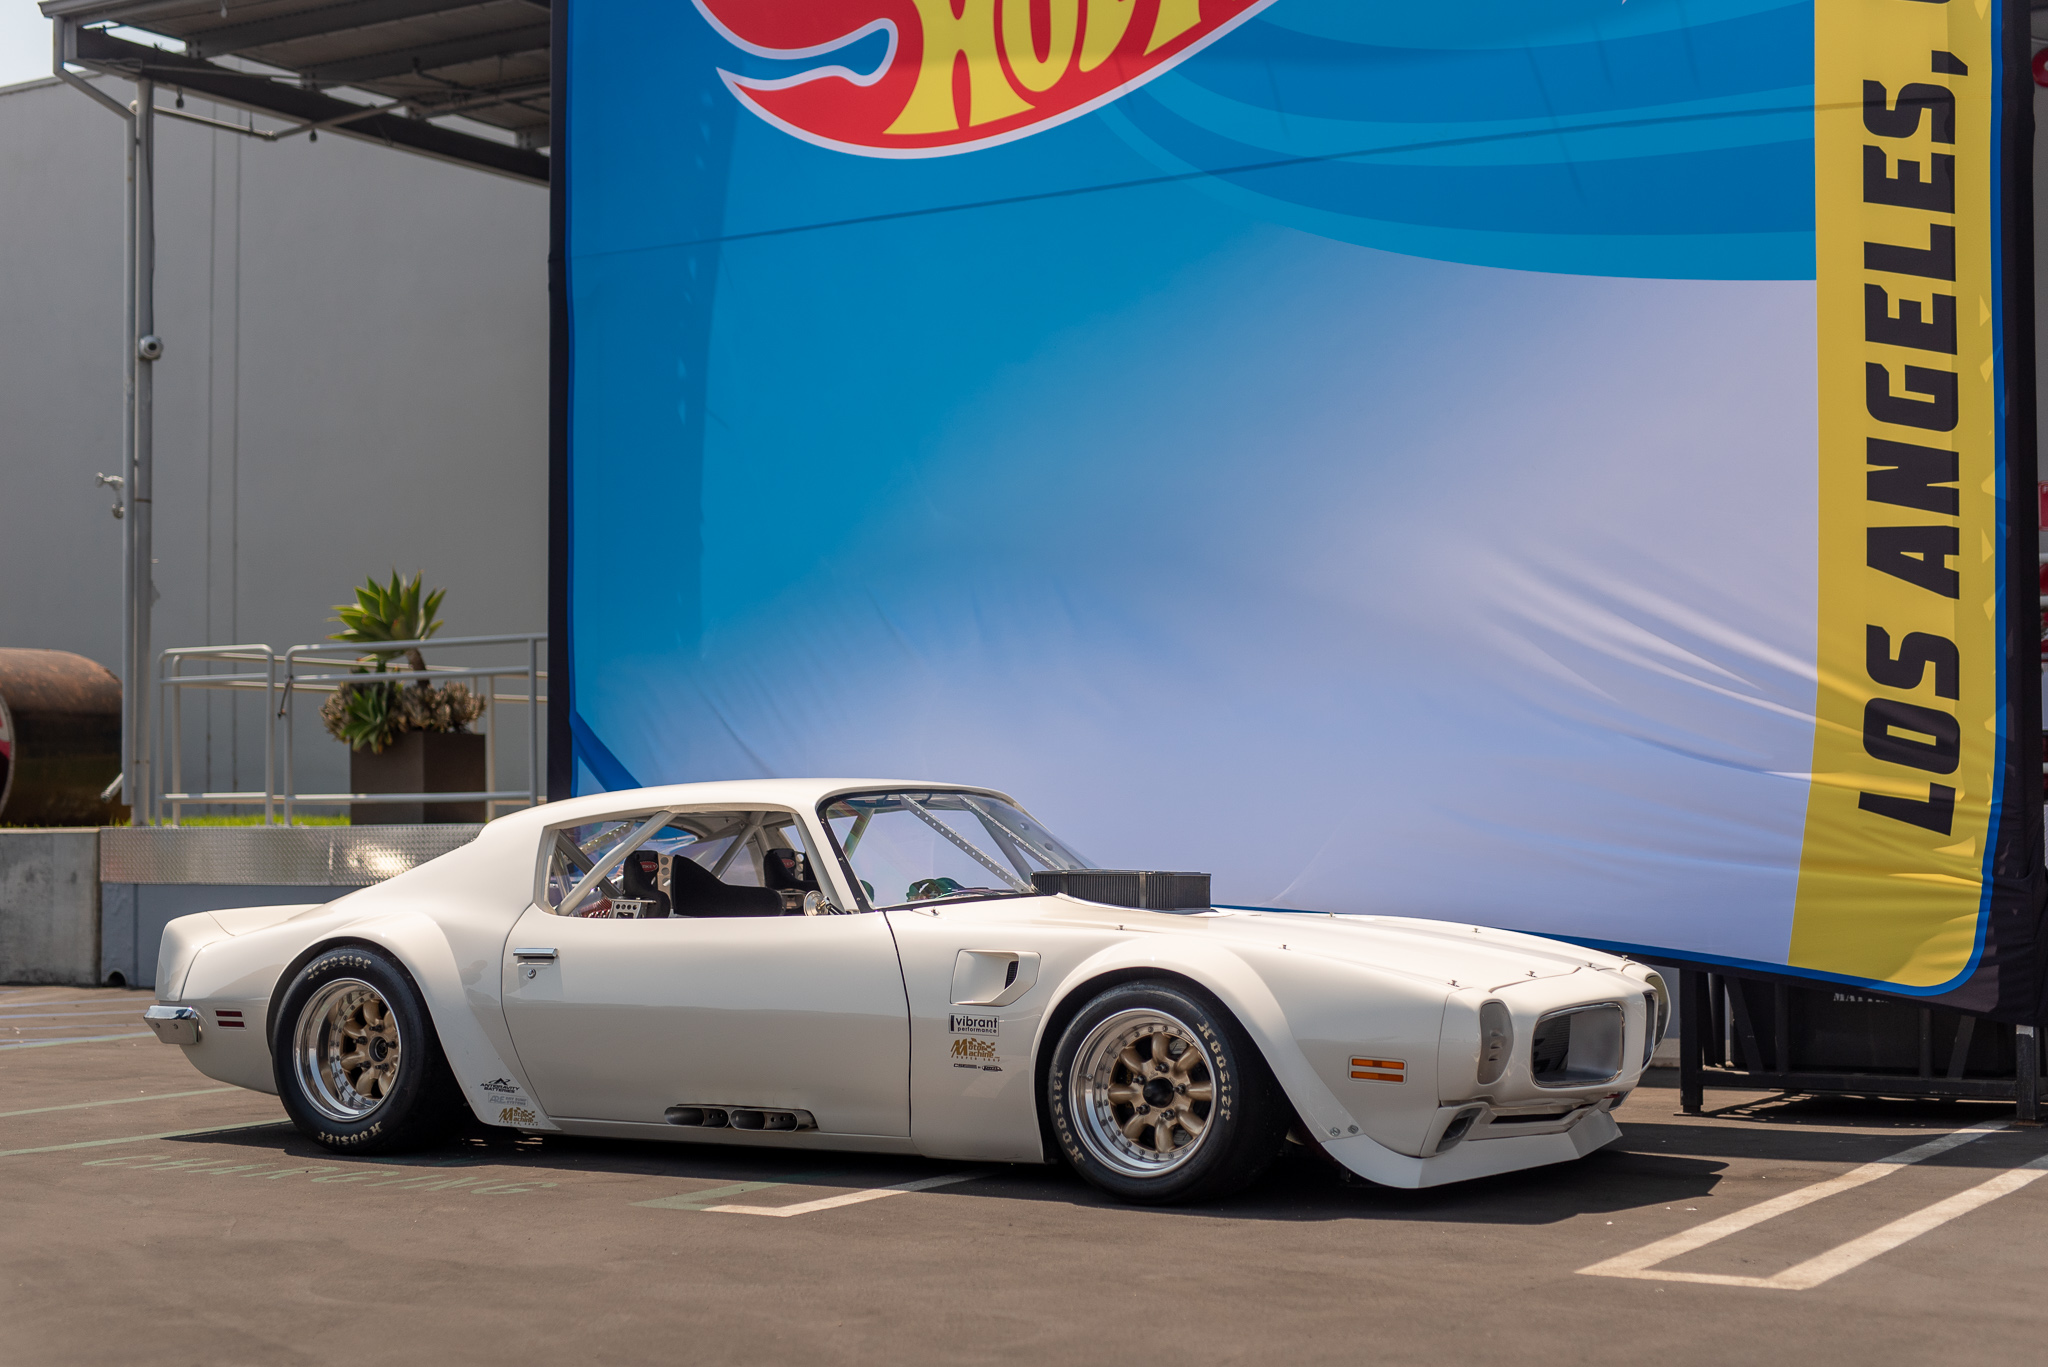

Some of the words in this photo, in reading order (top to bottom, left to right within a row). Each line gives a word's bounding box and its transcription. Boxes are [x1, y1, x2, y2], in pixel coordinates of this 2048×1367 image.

[1863, 50, 1968, 600] ANGELES,
[1858, 624, 1961, 836] LOS
[307, 955, 372, 980] Hoosier
[956, 1016, 997, 1028] vibrant
[1196, 1021, 1232, 1121] Hoosier
[317, 1120, 383, 1145] Hoosier
[1054, 1070, 1085, 1163] Hoosier
[82, 1155, 557, 1195] CHARGING
